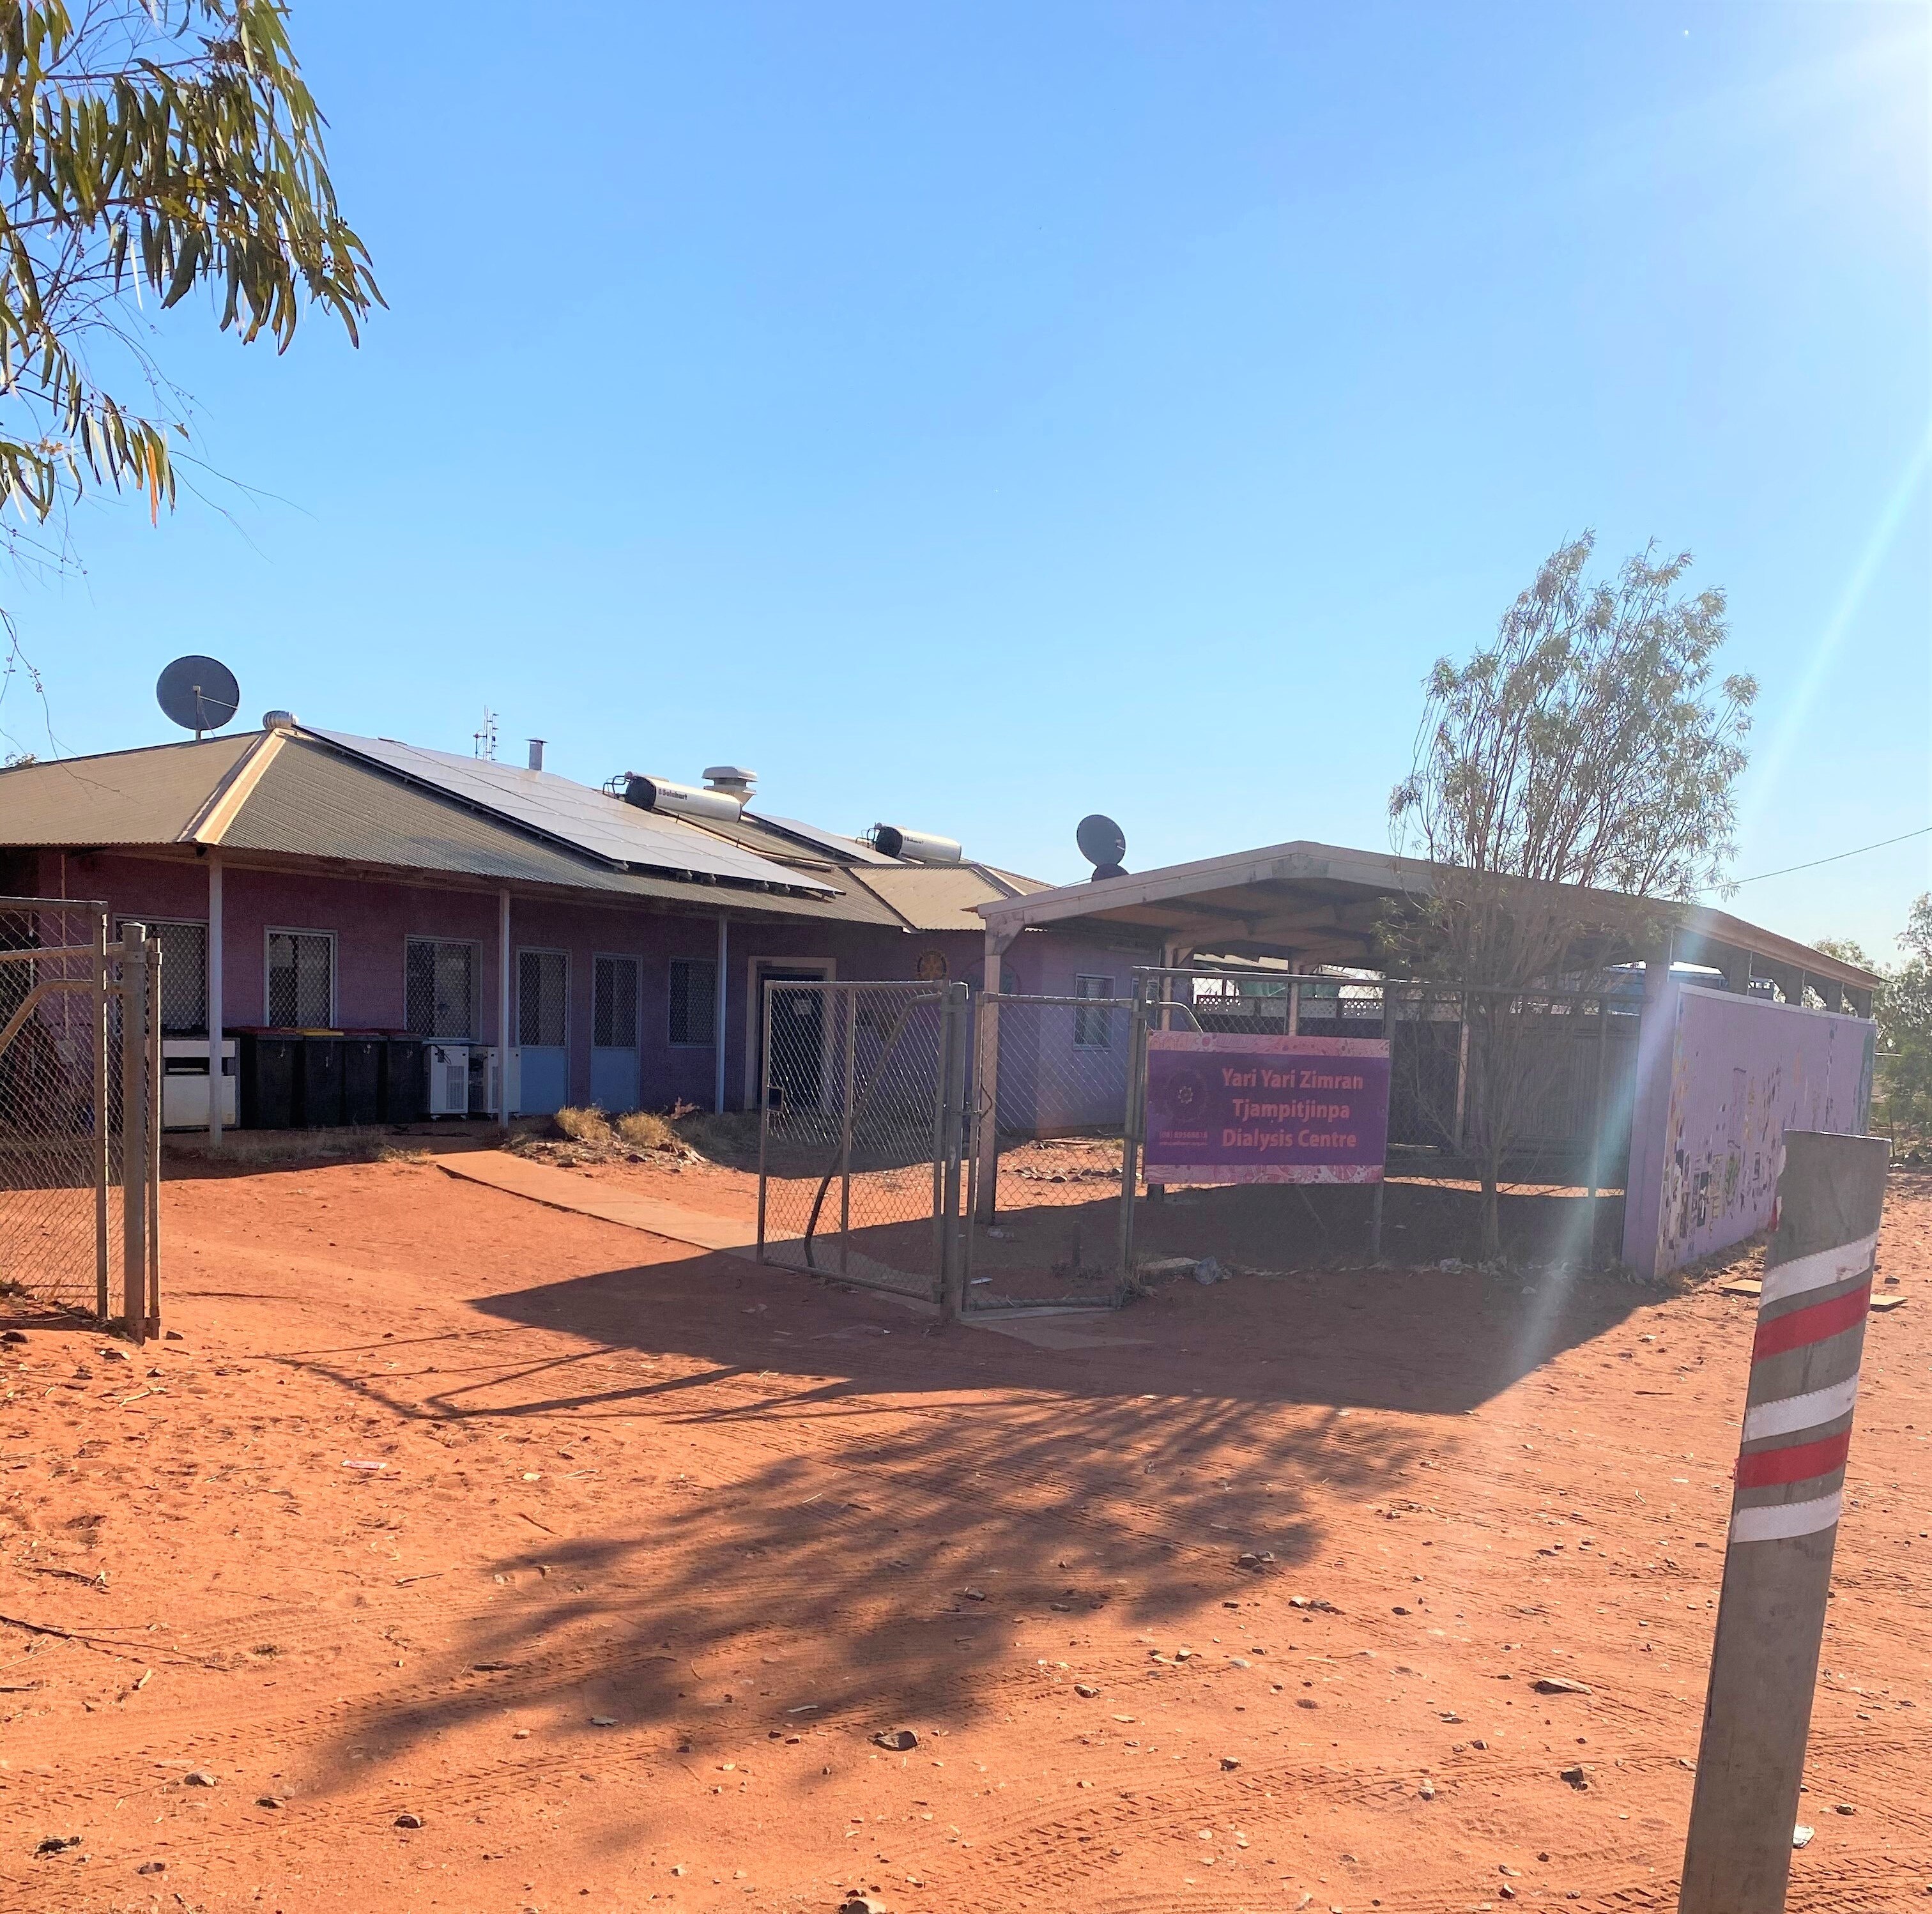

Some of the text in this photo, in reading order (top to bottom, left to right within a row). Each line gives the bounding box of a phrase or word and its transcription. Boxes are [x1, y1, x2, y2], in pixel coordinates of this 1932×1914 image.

[1222, 1068, 1363, 1089] Yari Yari Zimran
[1232, 1099, 1350, 1122] Tjampitjinpa
[1222, 1128, 1356, 1151] Dialysis Centre
